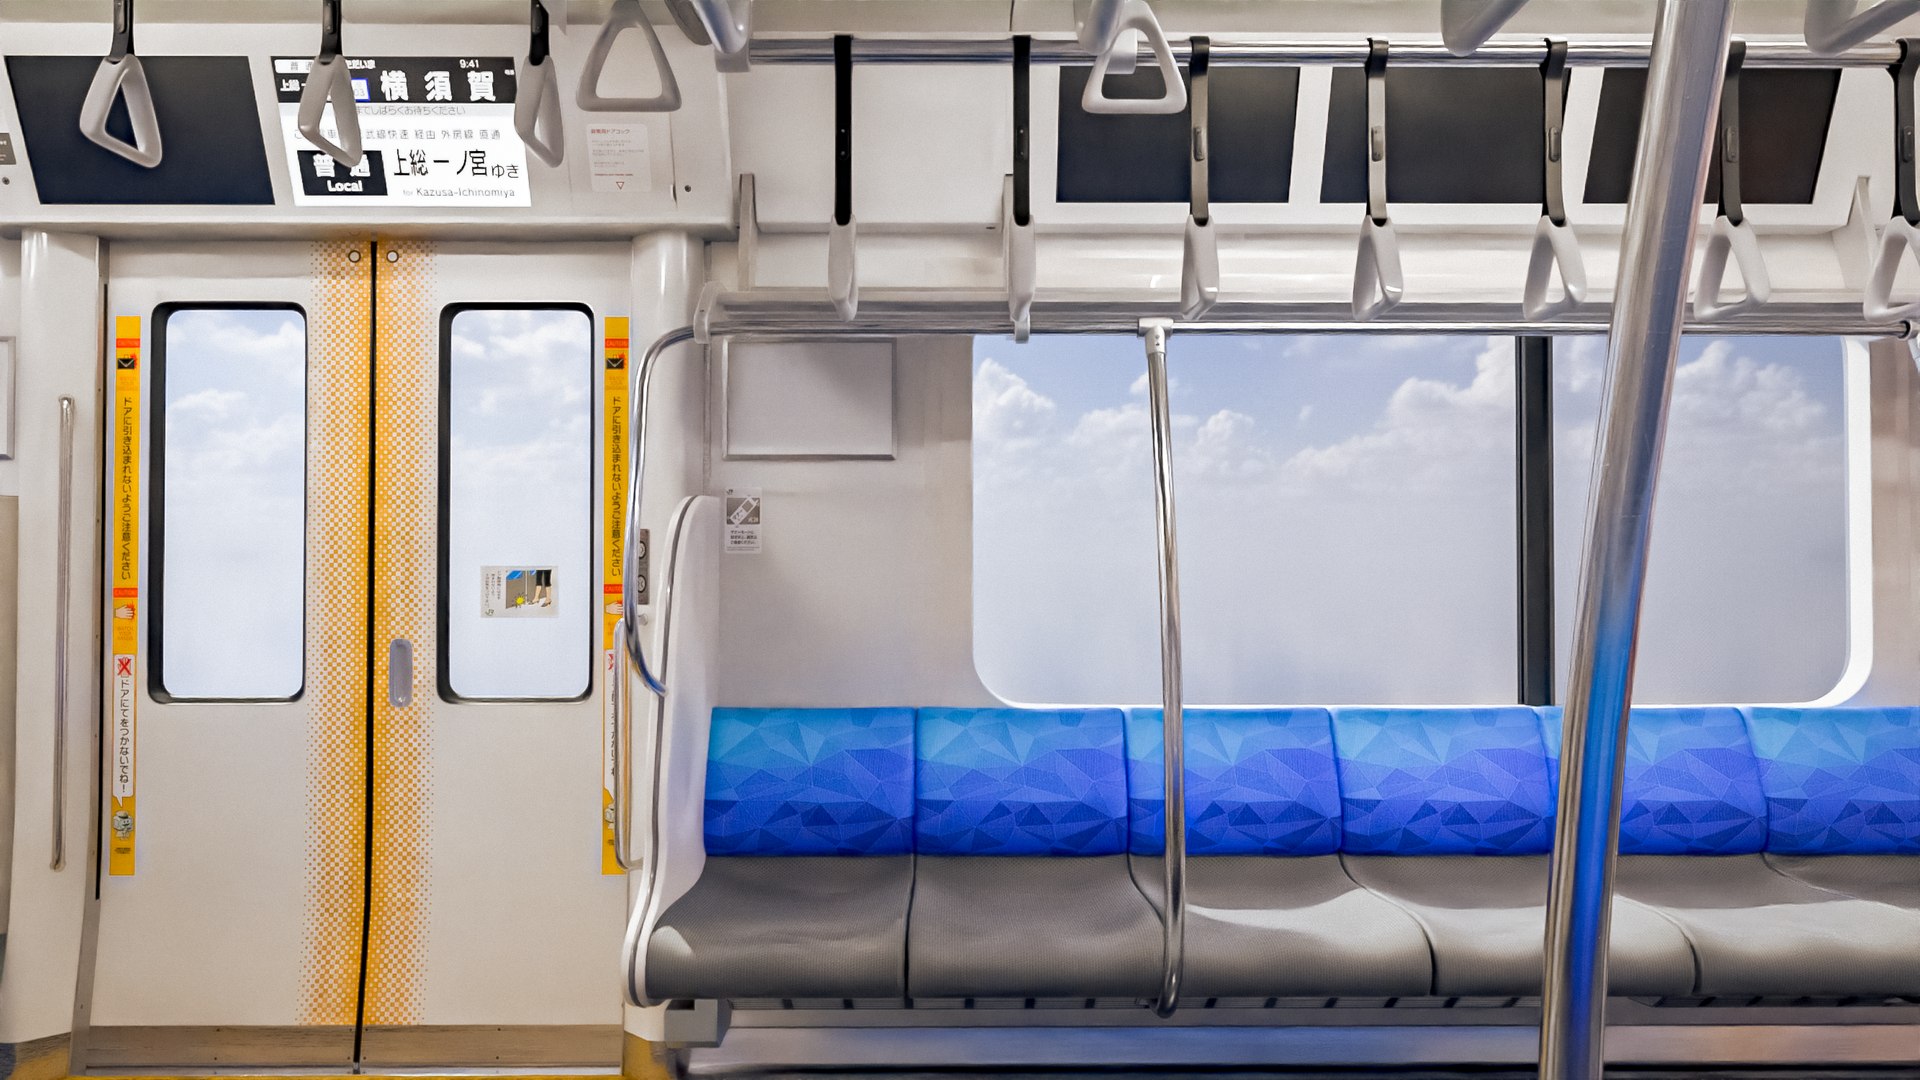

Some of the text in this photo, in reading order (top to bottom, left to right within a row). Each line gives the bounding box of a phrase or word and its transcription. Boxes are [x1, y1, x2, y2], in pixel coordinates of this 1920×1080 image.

[459, 59, 480, 68] 9:41
[380, 70, 496, 101] 横須賀
[327, 180, 363, 192] Local
[416, 188, 515, 198] Kazusa-Ichinomiya
